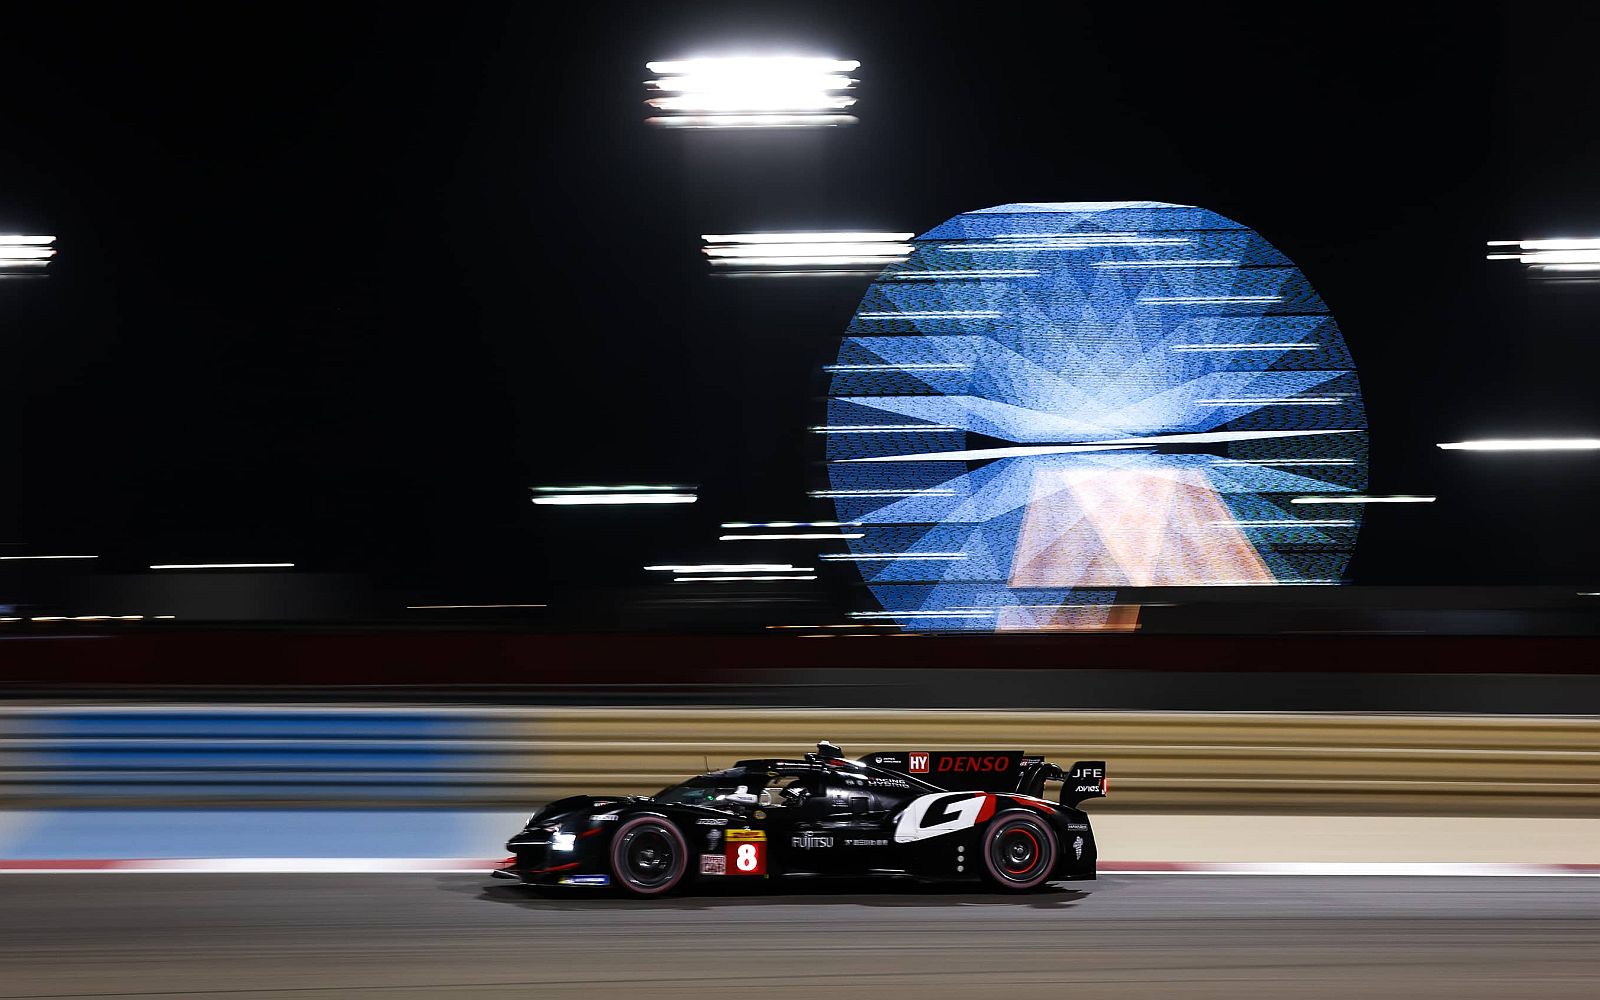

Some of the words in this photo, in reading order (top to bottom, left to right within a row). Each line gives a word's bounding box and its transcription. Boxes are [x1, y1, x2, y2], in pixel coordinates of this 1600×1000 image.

[910, 756, 927, 770] HY
[937, 757, 1009, 772] DENSO
[1072, 769, 1102, 778] JFE
[792, 836, 834, 850] FUJITSU
[736, 843, 758, 871] 8
